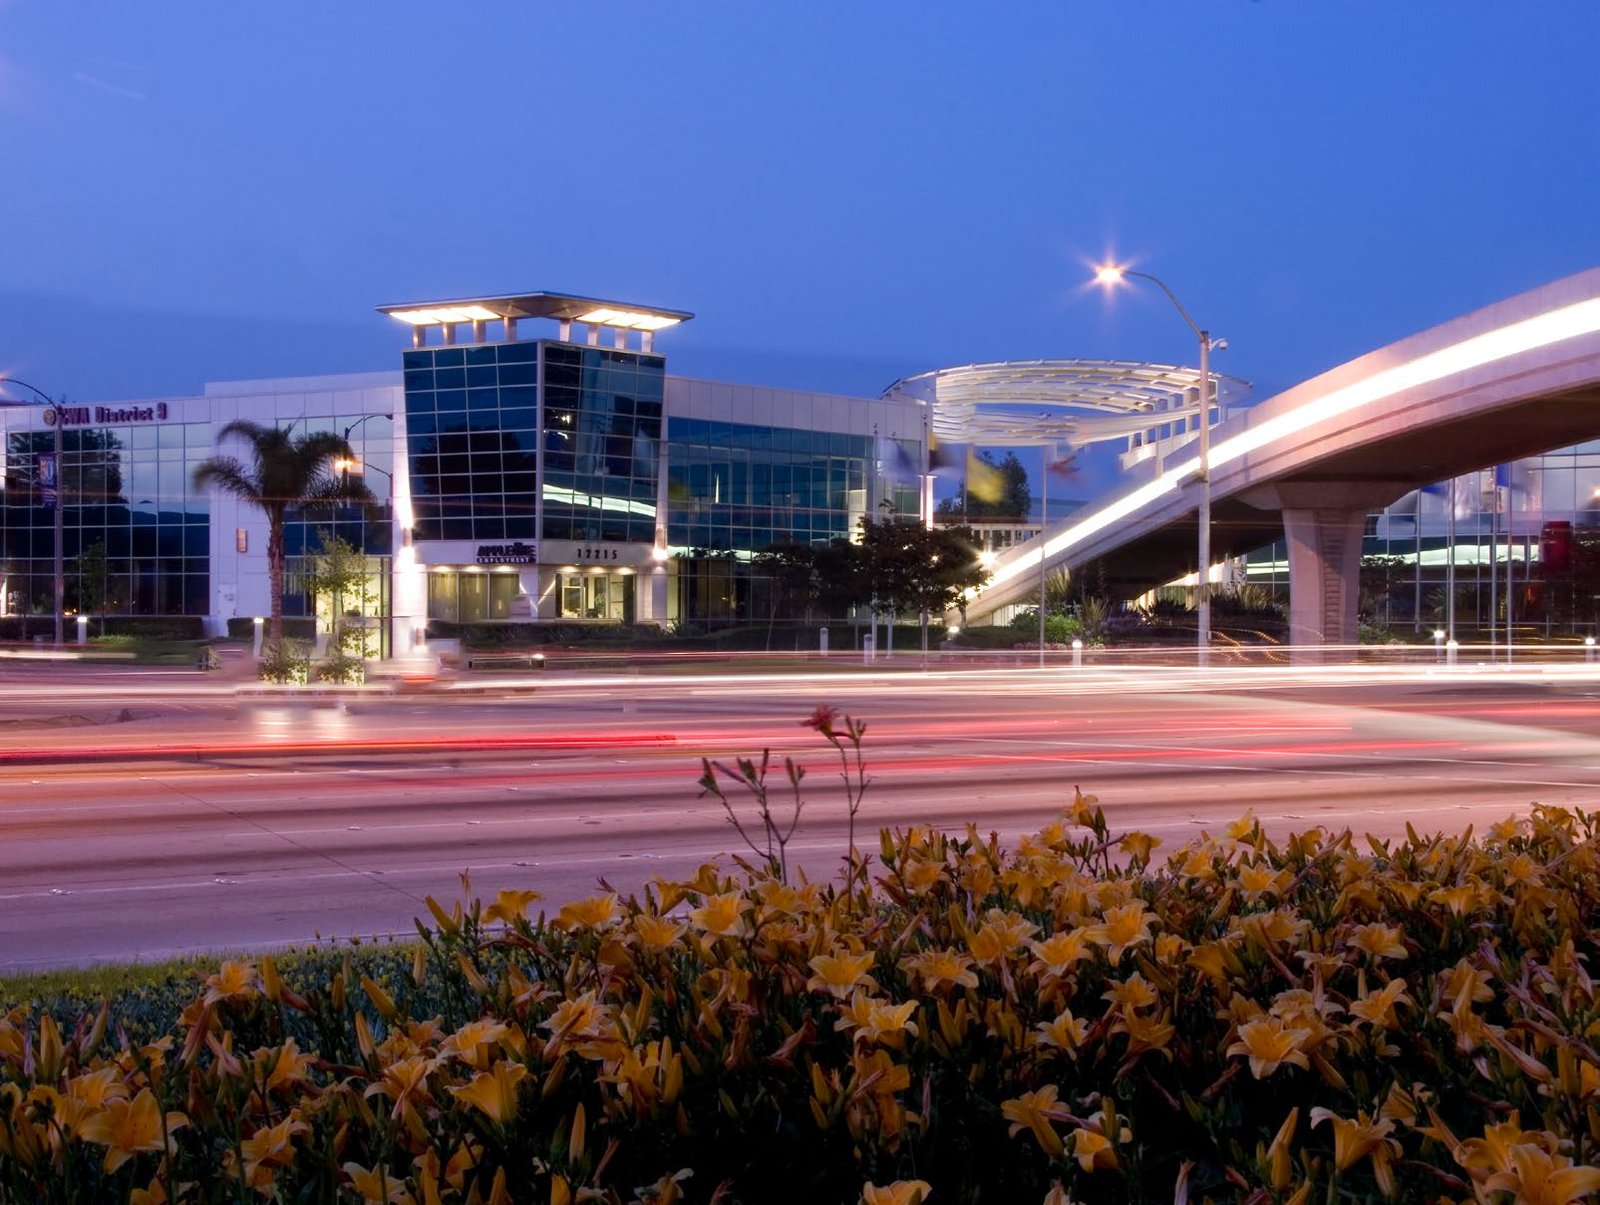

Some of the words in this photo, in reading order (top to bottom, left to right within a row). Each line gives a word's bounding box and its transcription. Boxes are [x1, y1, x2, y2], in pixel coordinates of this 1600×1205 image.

[95, 406, 154, 423] District
[157, 402, 167, 420] 9
[477, 556, 530, 564] EMPLOYMENT
[577, 548, 618, 560] 12215
